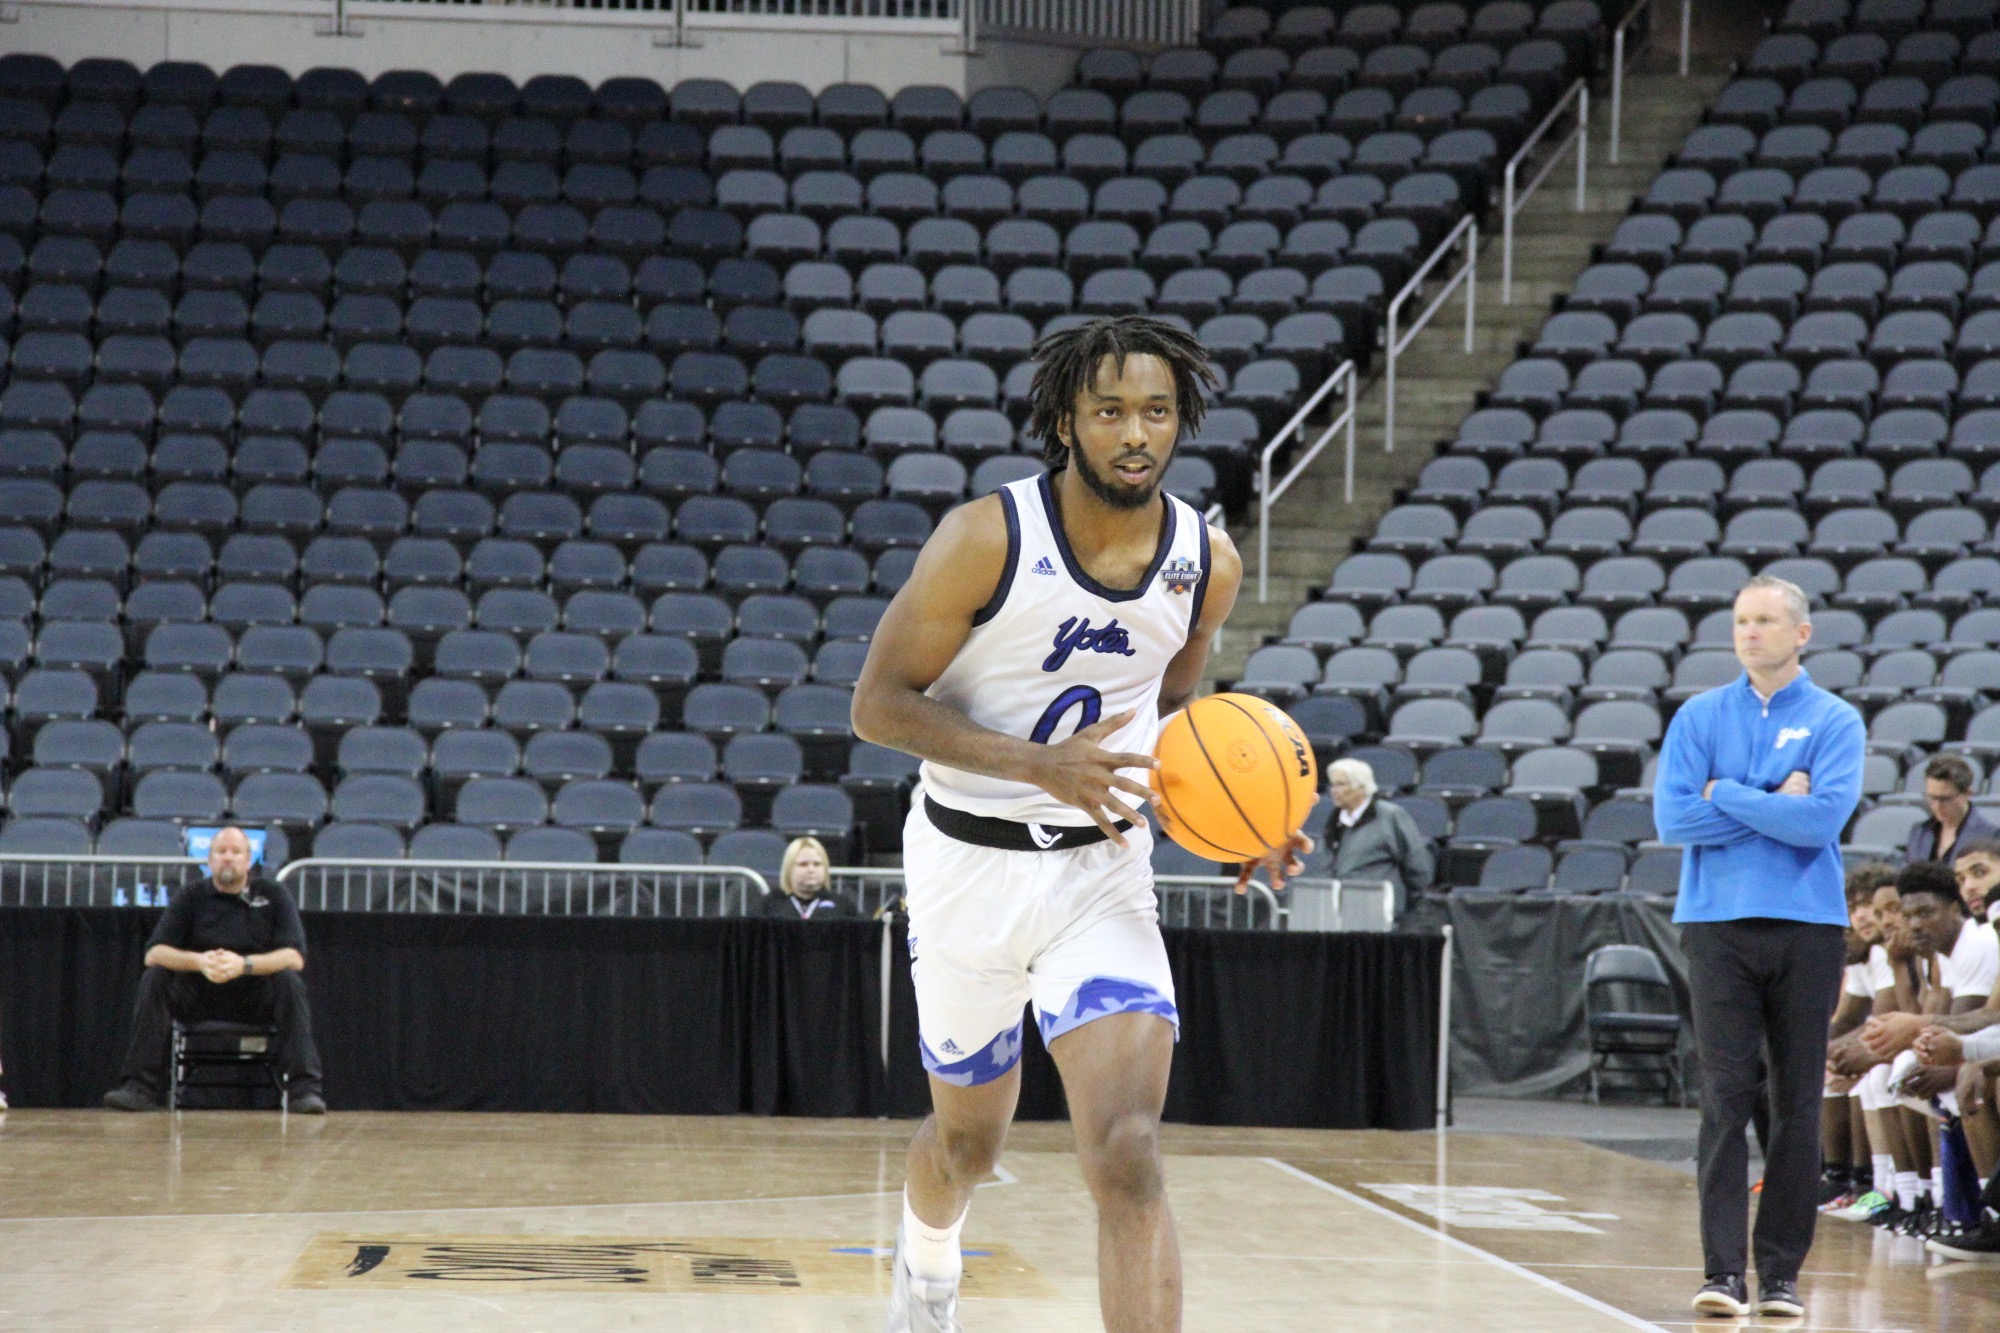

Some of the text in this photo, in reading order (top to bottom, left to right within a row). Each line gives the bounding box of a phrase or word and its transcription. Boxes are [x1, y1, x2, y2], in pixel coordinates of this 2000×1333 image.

[1031, 566, 1057, 575] adidas
[1164, 572, 1199, 580] ELITE EIGHT
